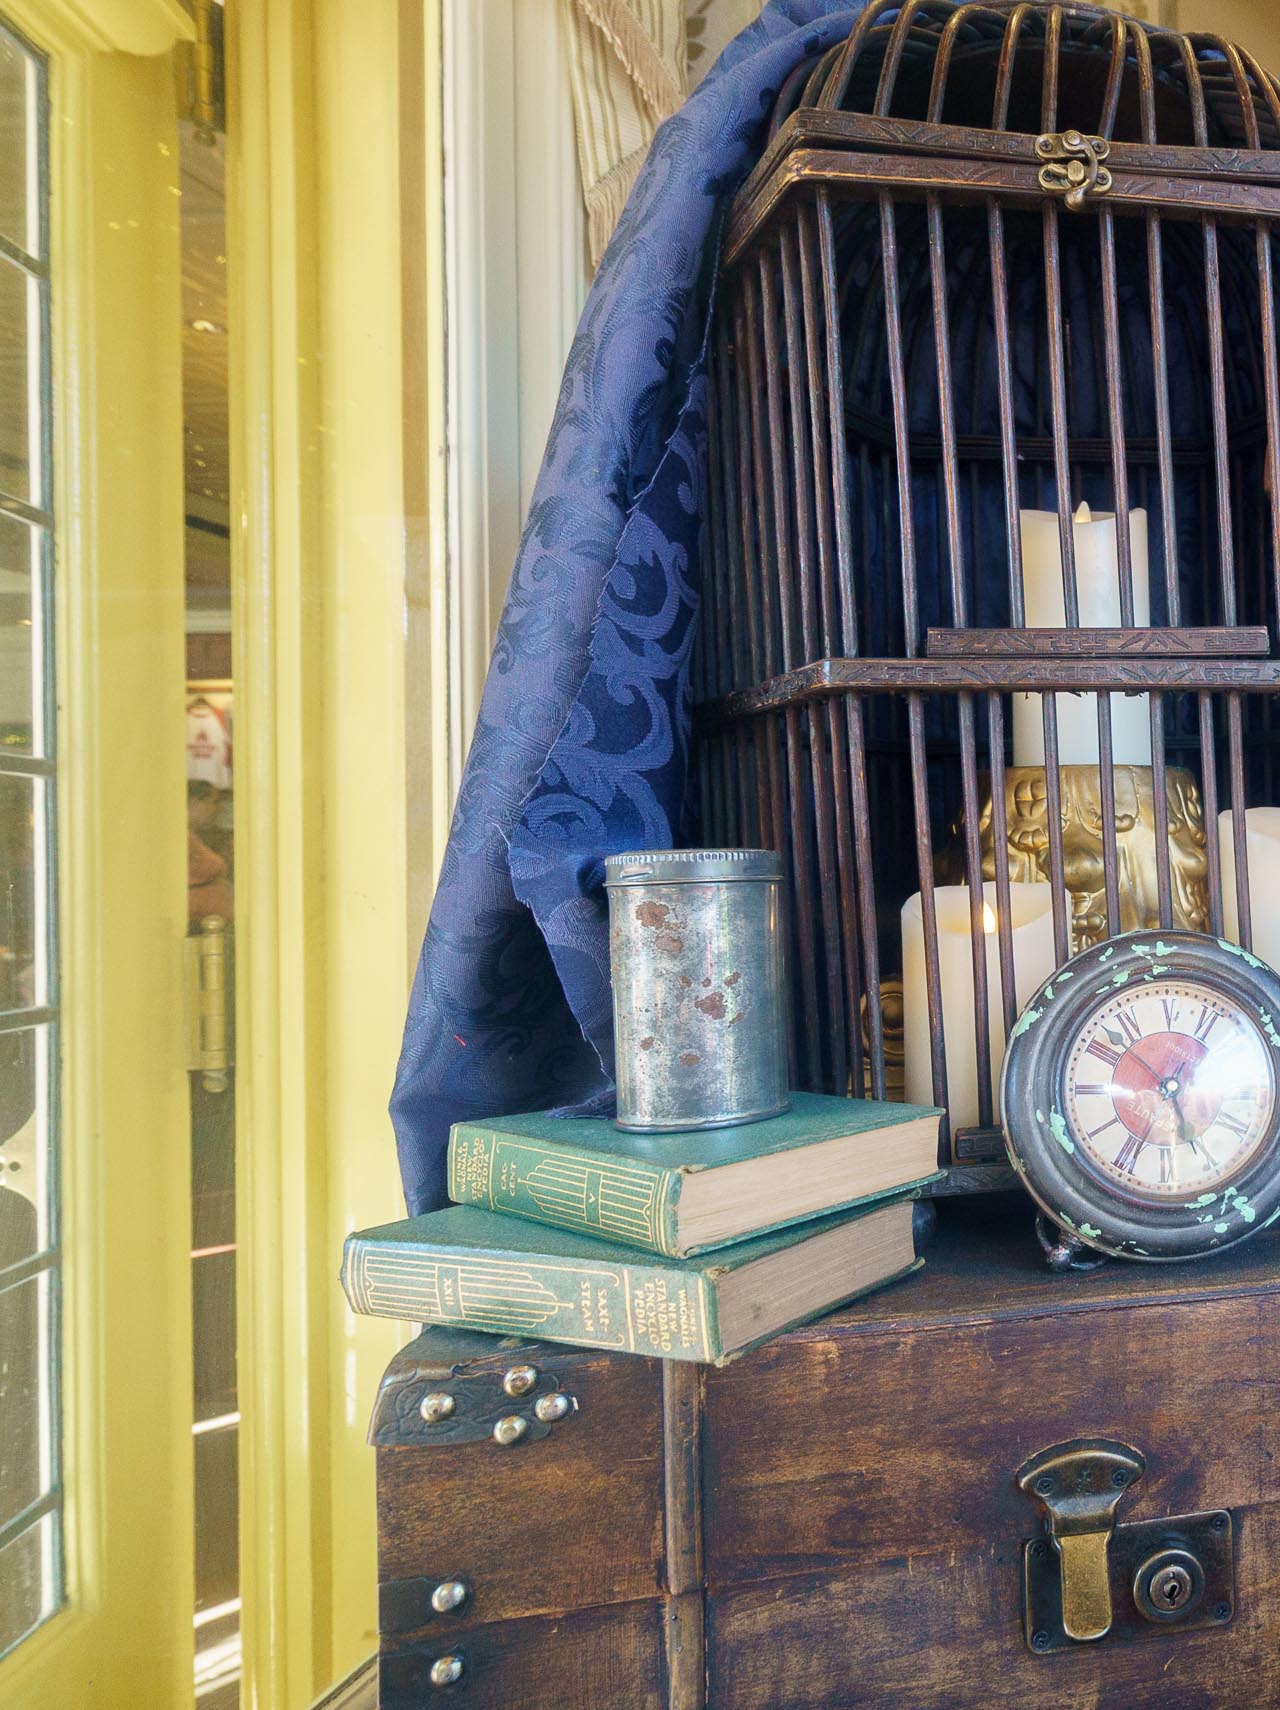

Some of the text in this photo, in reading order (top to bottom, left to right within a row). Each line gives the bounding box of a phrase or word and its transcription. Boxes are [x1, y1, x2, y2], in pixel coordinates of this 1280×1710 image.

[471, 1137, 480, 1200] STANDARD
[509, 1161, 517, 1197] CENT
[580, 1280, 594, 1332] STEAM
[634, 1290, 648, 1335] PEDIA
[655, 1278, 672, 1352] STANDARD
[668, 1302, 677, 1333] NEW
